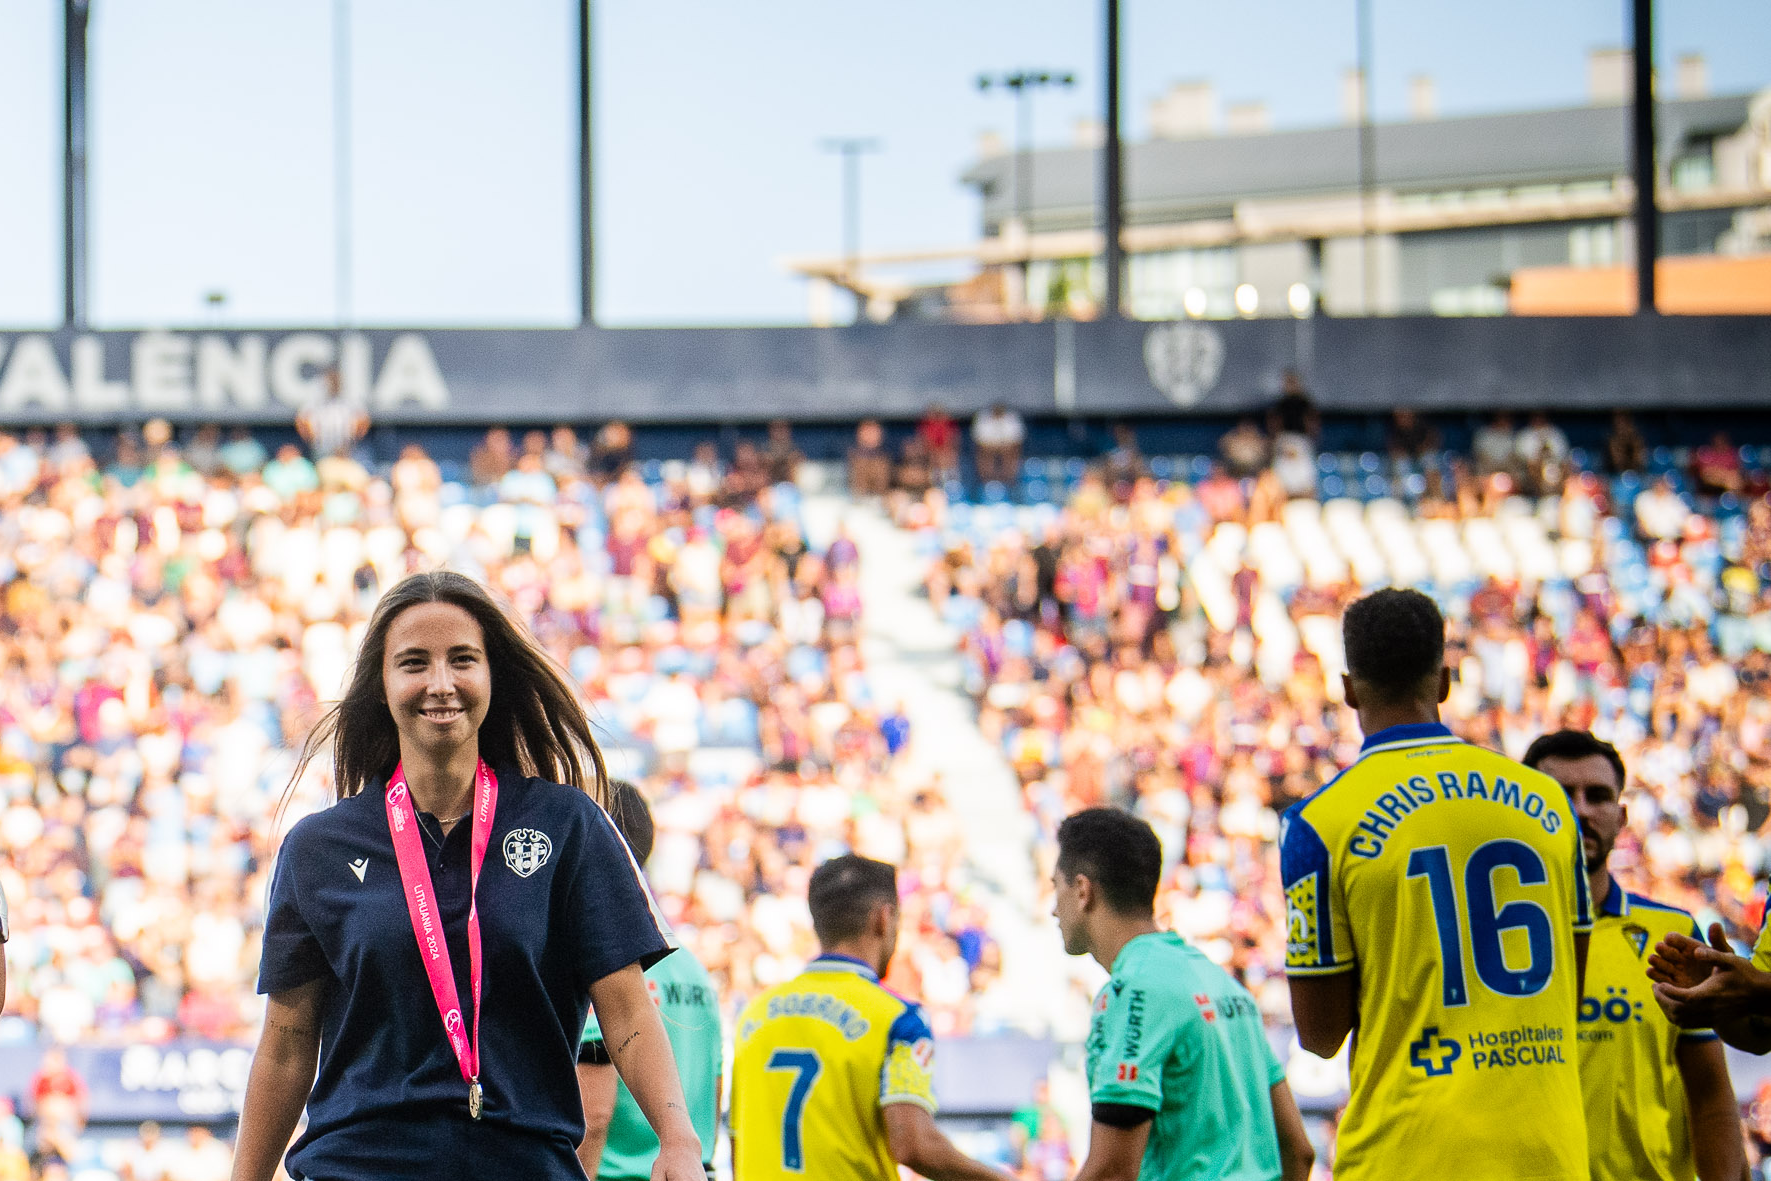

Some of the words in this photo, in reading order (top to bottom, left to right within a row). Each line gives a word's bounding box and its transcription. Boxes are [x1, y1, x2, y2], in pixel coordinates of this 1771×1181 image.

[1349, 775, 1435, 860] CHRIS
[1436, 770, 1563, 835] RAMOS
[413, 884, 433, 935] LITHUANIA
[426, 935, 440, 960] 2024
[1406, 837, 1556, 1009] 16
[1468, 1023, 1563, 1048] Hospitales
[1473, 1045, 1566, 1070] PASCUAL
[765, 1047, 823, 1175] 7
